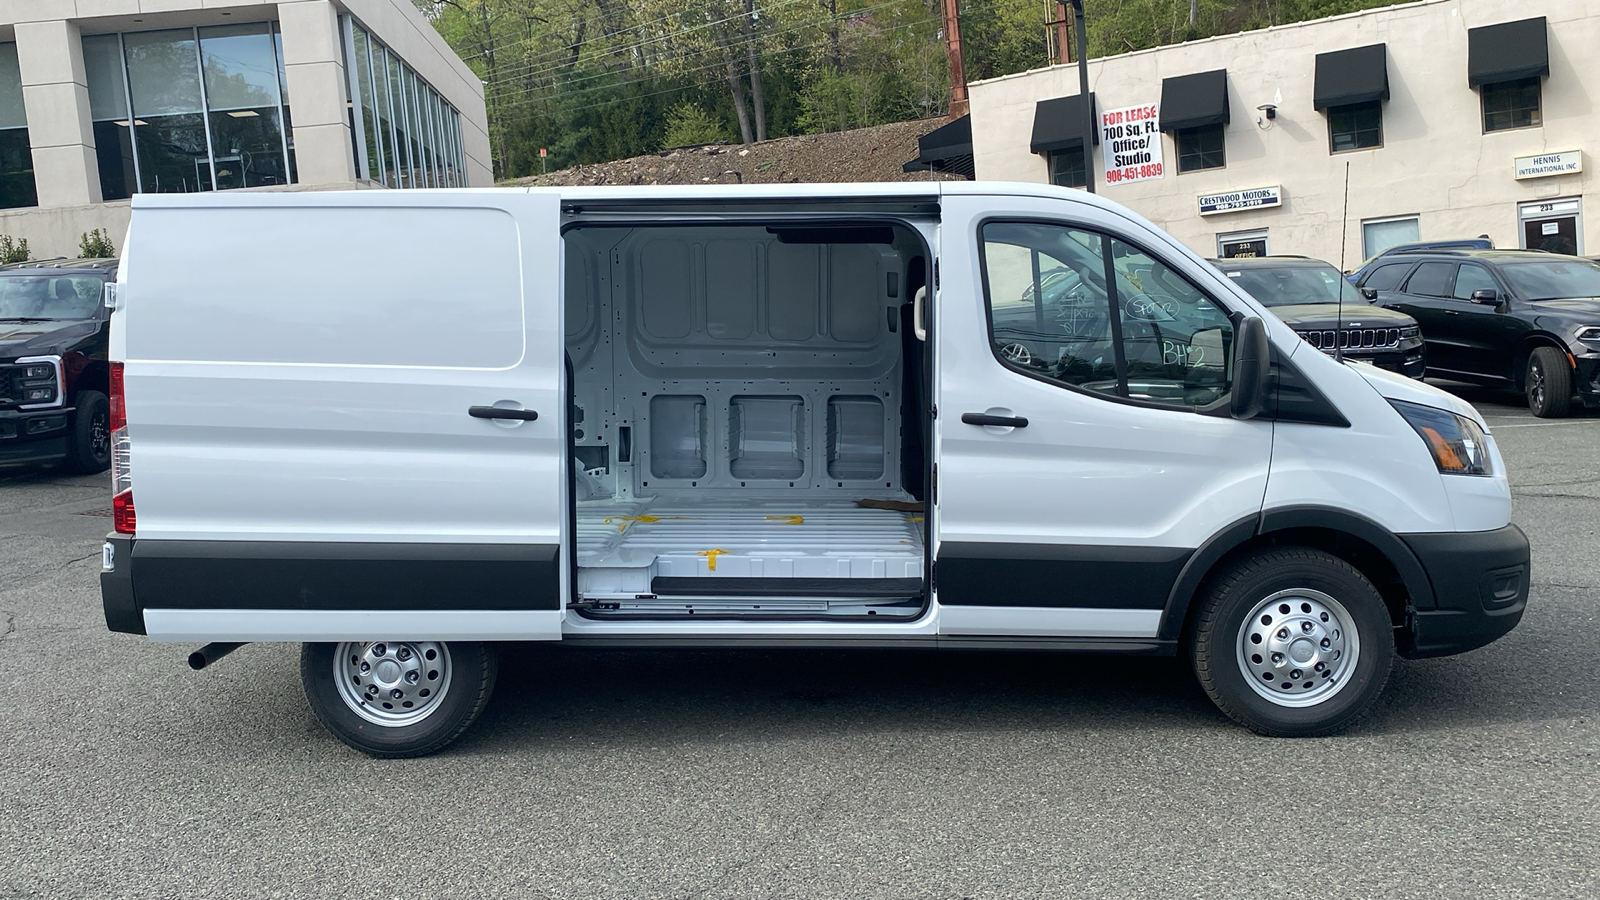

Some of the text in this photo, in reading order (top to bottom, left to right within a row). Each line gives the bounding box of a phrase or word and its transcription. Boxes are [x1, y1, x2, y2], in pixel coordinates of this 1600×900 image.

[1103, 105, 1157, 126] FOR LEASE
[1103, 121, 1158, 140] 700 Sq. Ft.
[1113, 135, 1150, 153] Office/
[1114, 152, 1151, 167] Studio
[1533, 155, 1561, 165] HENNIS
[1106, 162, 1163, 183] 908-451-8839
[1519, 164, 1565, 175] INTERNATIONAL
[1199, 194, 1240, 206] CRESTWOOD
[1241, 189, 1271, 200] MOTORS
[1540, 204, 1553, 212] 233
